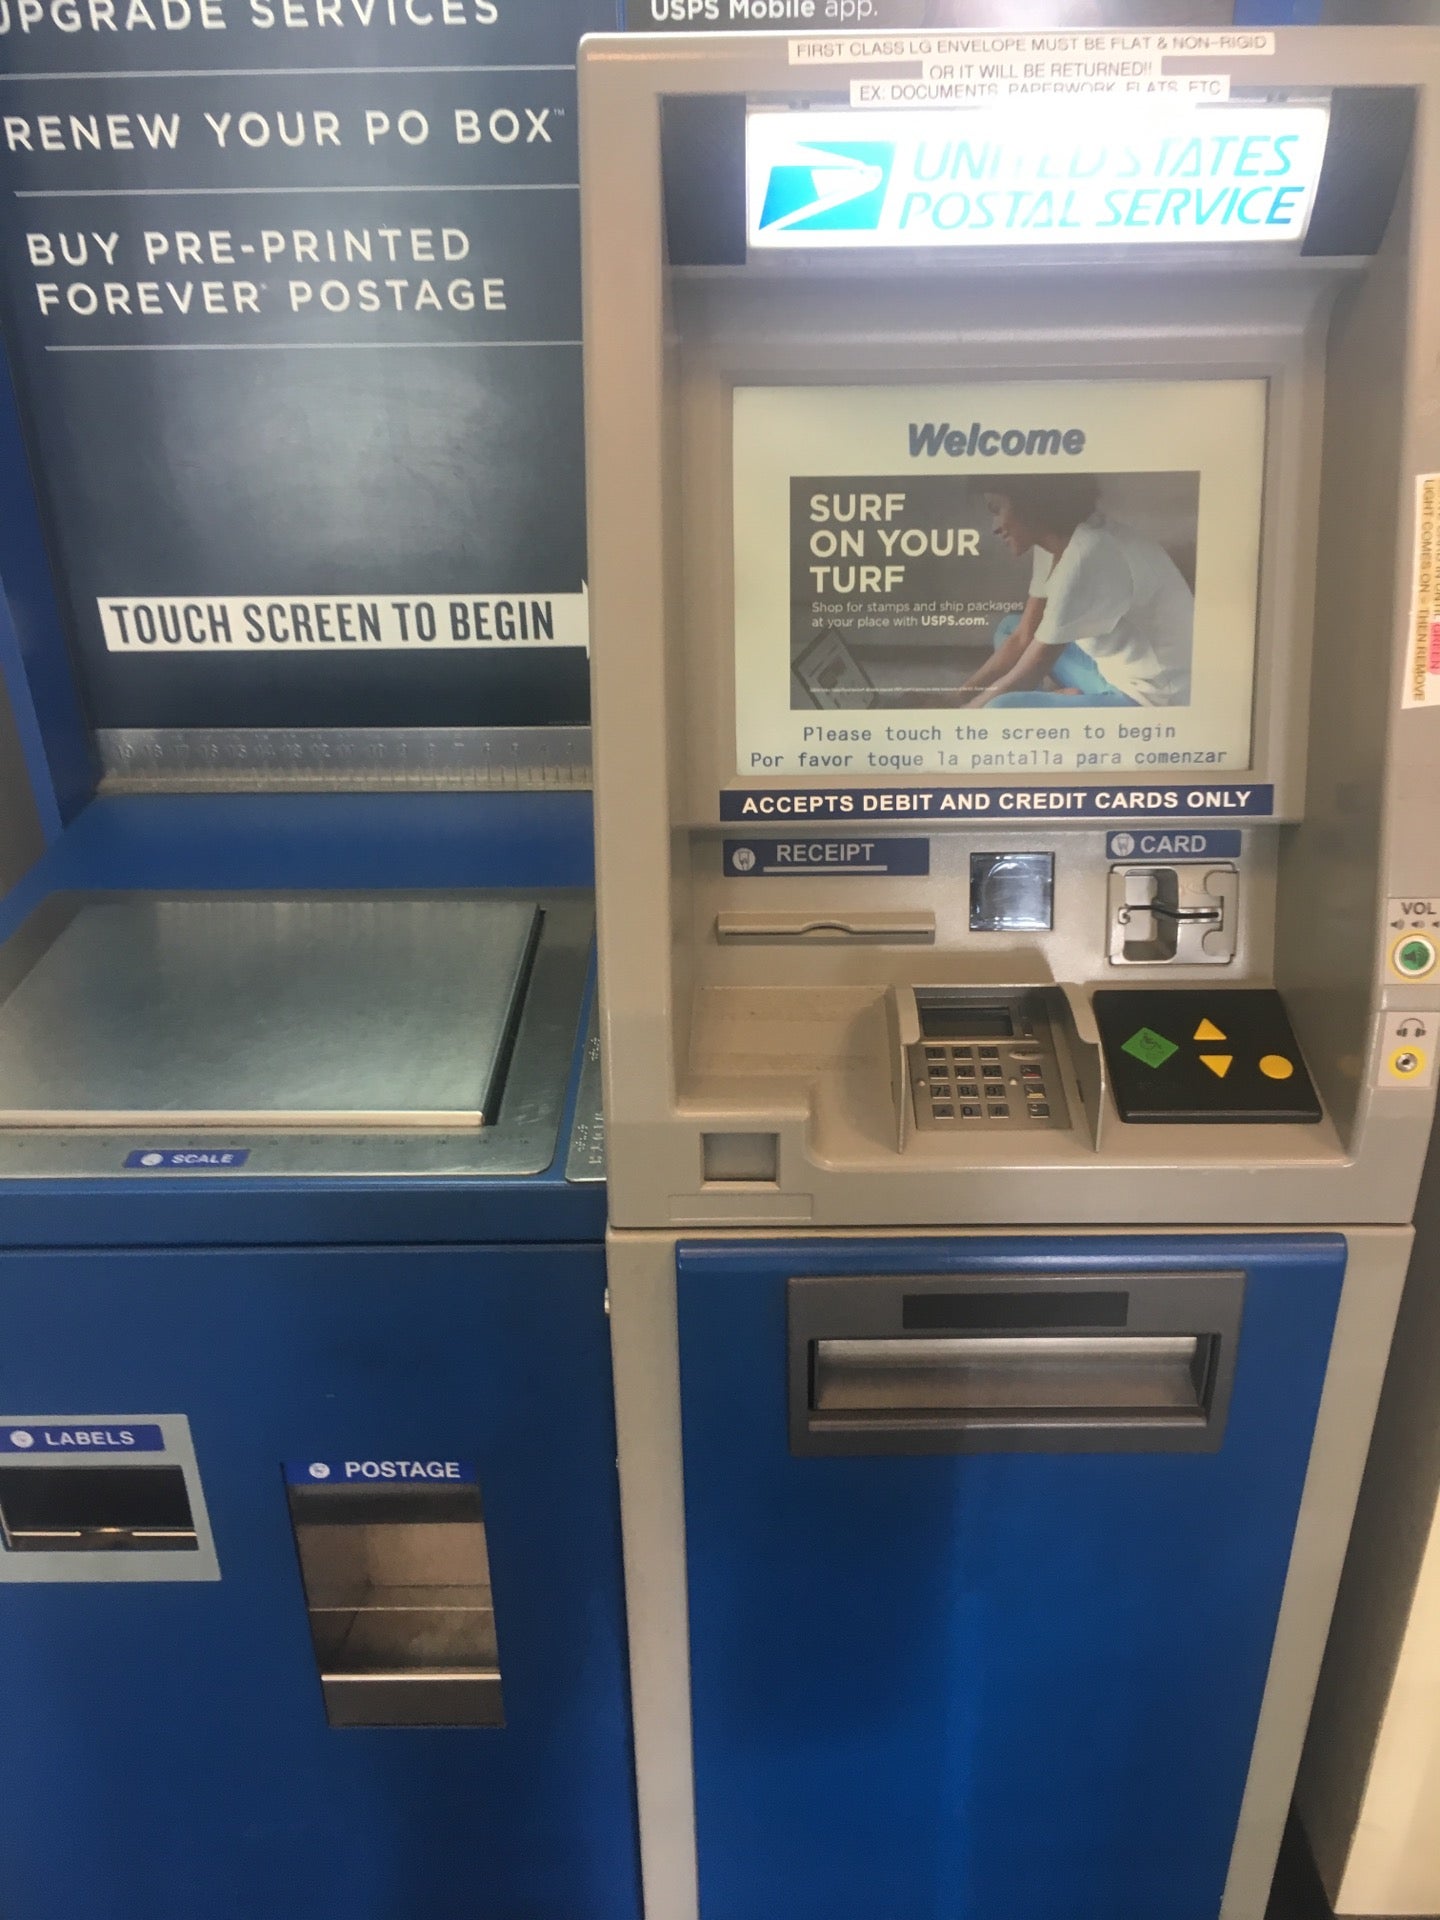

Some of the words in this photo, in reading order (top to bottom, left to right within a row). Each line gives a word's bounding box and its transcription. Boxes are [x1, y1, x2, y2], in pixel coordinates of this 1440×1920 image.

[251, 0, 499, 30] SERVICES
[651, 0, 720, 21] USPS
[729, 0, 816, 20] Mobile
[824, 0, 878, 22] app.
[797, 43, 845, 58] FIRST
[850, 41, 905, 57] CLASS
[909, 41, 932, 55] LG
[937, 38, 1027, 54] ENVELOPE
[1031, 37, 1077, 52] MUST
[1084, 37, 1106, 51] BE
[1111, 36, 1152, 51] FLAT
[1157, 36, 1168, 50] &
[1172, 35, 1267, 50] NON-RIGID
[929, 64, 954, 80] OR
[960, 64, 974, 79] IT
[979, 63, 1018, 79] WILL
[1023, 63, 1046, 79] BE
[3, 113, 181, 151] RENEW
[204, 111, 341, 148] YOUR
[365, 110, 430, 145] PO
[1115, 134, 1300, 177] STATES
[898, 189, 1082, 230] POSTAL
[1095, 186, 1305, 227] SERVICE
[26, 232, 120, 267] BUY
[144, 228, 471, 265] PRE-PRINTED
[288, 278, 508, 313] POSTAGE
[907, 422, 1087, 458] Welcome
[808, 492, 907, 523] SURF
[1422, 479, 1435, 517] LIGHT
[809, 529, 865, 558] ON
[877, 528, 981, 557] YOUR
[1421, 521, 1434, 570] COMES
[808, 565, 906, 594] TURF
[1419, 573, 1432, 593] ON
[811, 601, 843, 615] Shop
[846, 601, 863, 613] for
[866, 601, 910, 615] stamps
[913, 600, 937, 612] and
[940, 600, 964, 614] ship
[967, 600, 1024, 614] packages
[109, 604, 233, 645] TOUCH
[242, 602, 382, 643] SCREEN
[391, 601, 437, 642] TO
[449, 600, 555, 641] BEGIN
[811, 617, 824, 628] at
[826, 618, 854, 629] your
[857, 616, 890, 629] place
[893, 616, 919, 627] with
[1417, 609, 1430, 642] THEN
[1413, 646, 1427, 701] REMOVE
[803, 725, 872, 743] Please
[885, 724, 942, 742] touch
[955, 723, 988, 741] the
[1001, 726, 1071, 741] screen
[1083, 725, 1106, 740] to
[1117, 723, 1177, 744] begin
[750, 751, 785, 768] Por
[797, 750, 854, 767] favor
[867, 751, 924, 771] toque
[938, 750, 959, 766] la
[971, 749, 1064, 769] pantalla
[1076, 751, 1122, 769] para
[1134, 750, 1228, 764] comenzar
[742, 796, 854, 815] ACCEPTS
[862, 794, 933, 813] DEBIT
[940, 793, 990, 811] AND
[998, 792, 1087, 811] CREDIT
[1094, 791, 1179, 810] CARDS
[1186, 790, 1251, 809] ONLY
[776, 843, 875, 863] RECEIPT
[1140, 835, 1208, 854] CARD
[1400, 901, 1437, 916] VOL
[171, 1152, 235, 1165] SCALE
[44, 1430, 136, 1446] LABELS
[345, 1461, 461, 1479] POSTAGE
